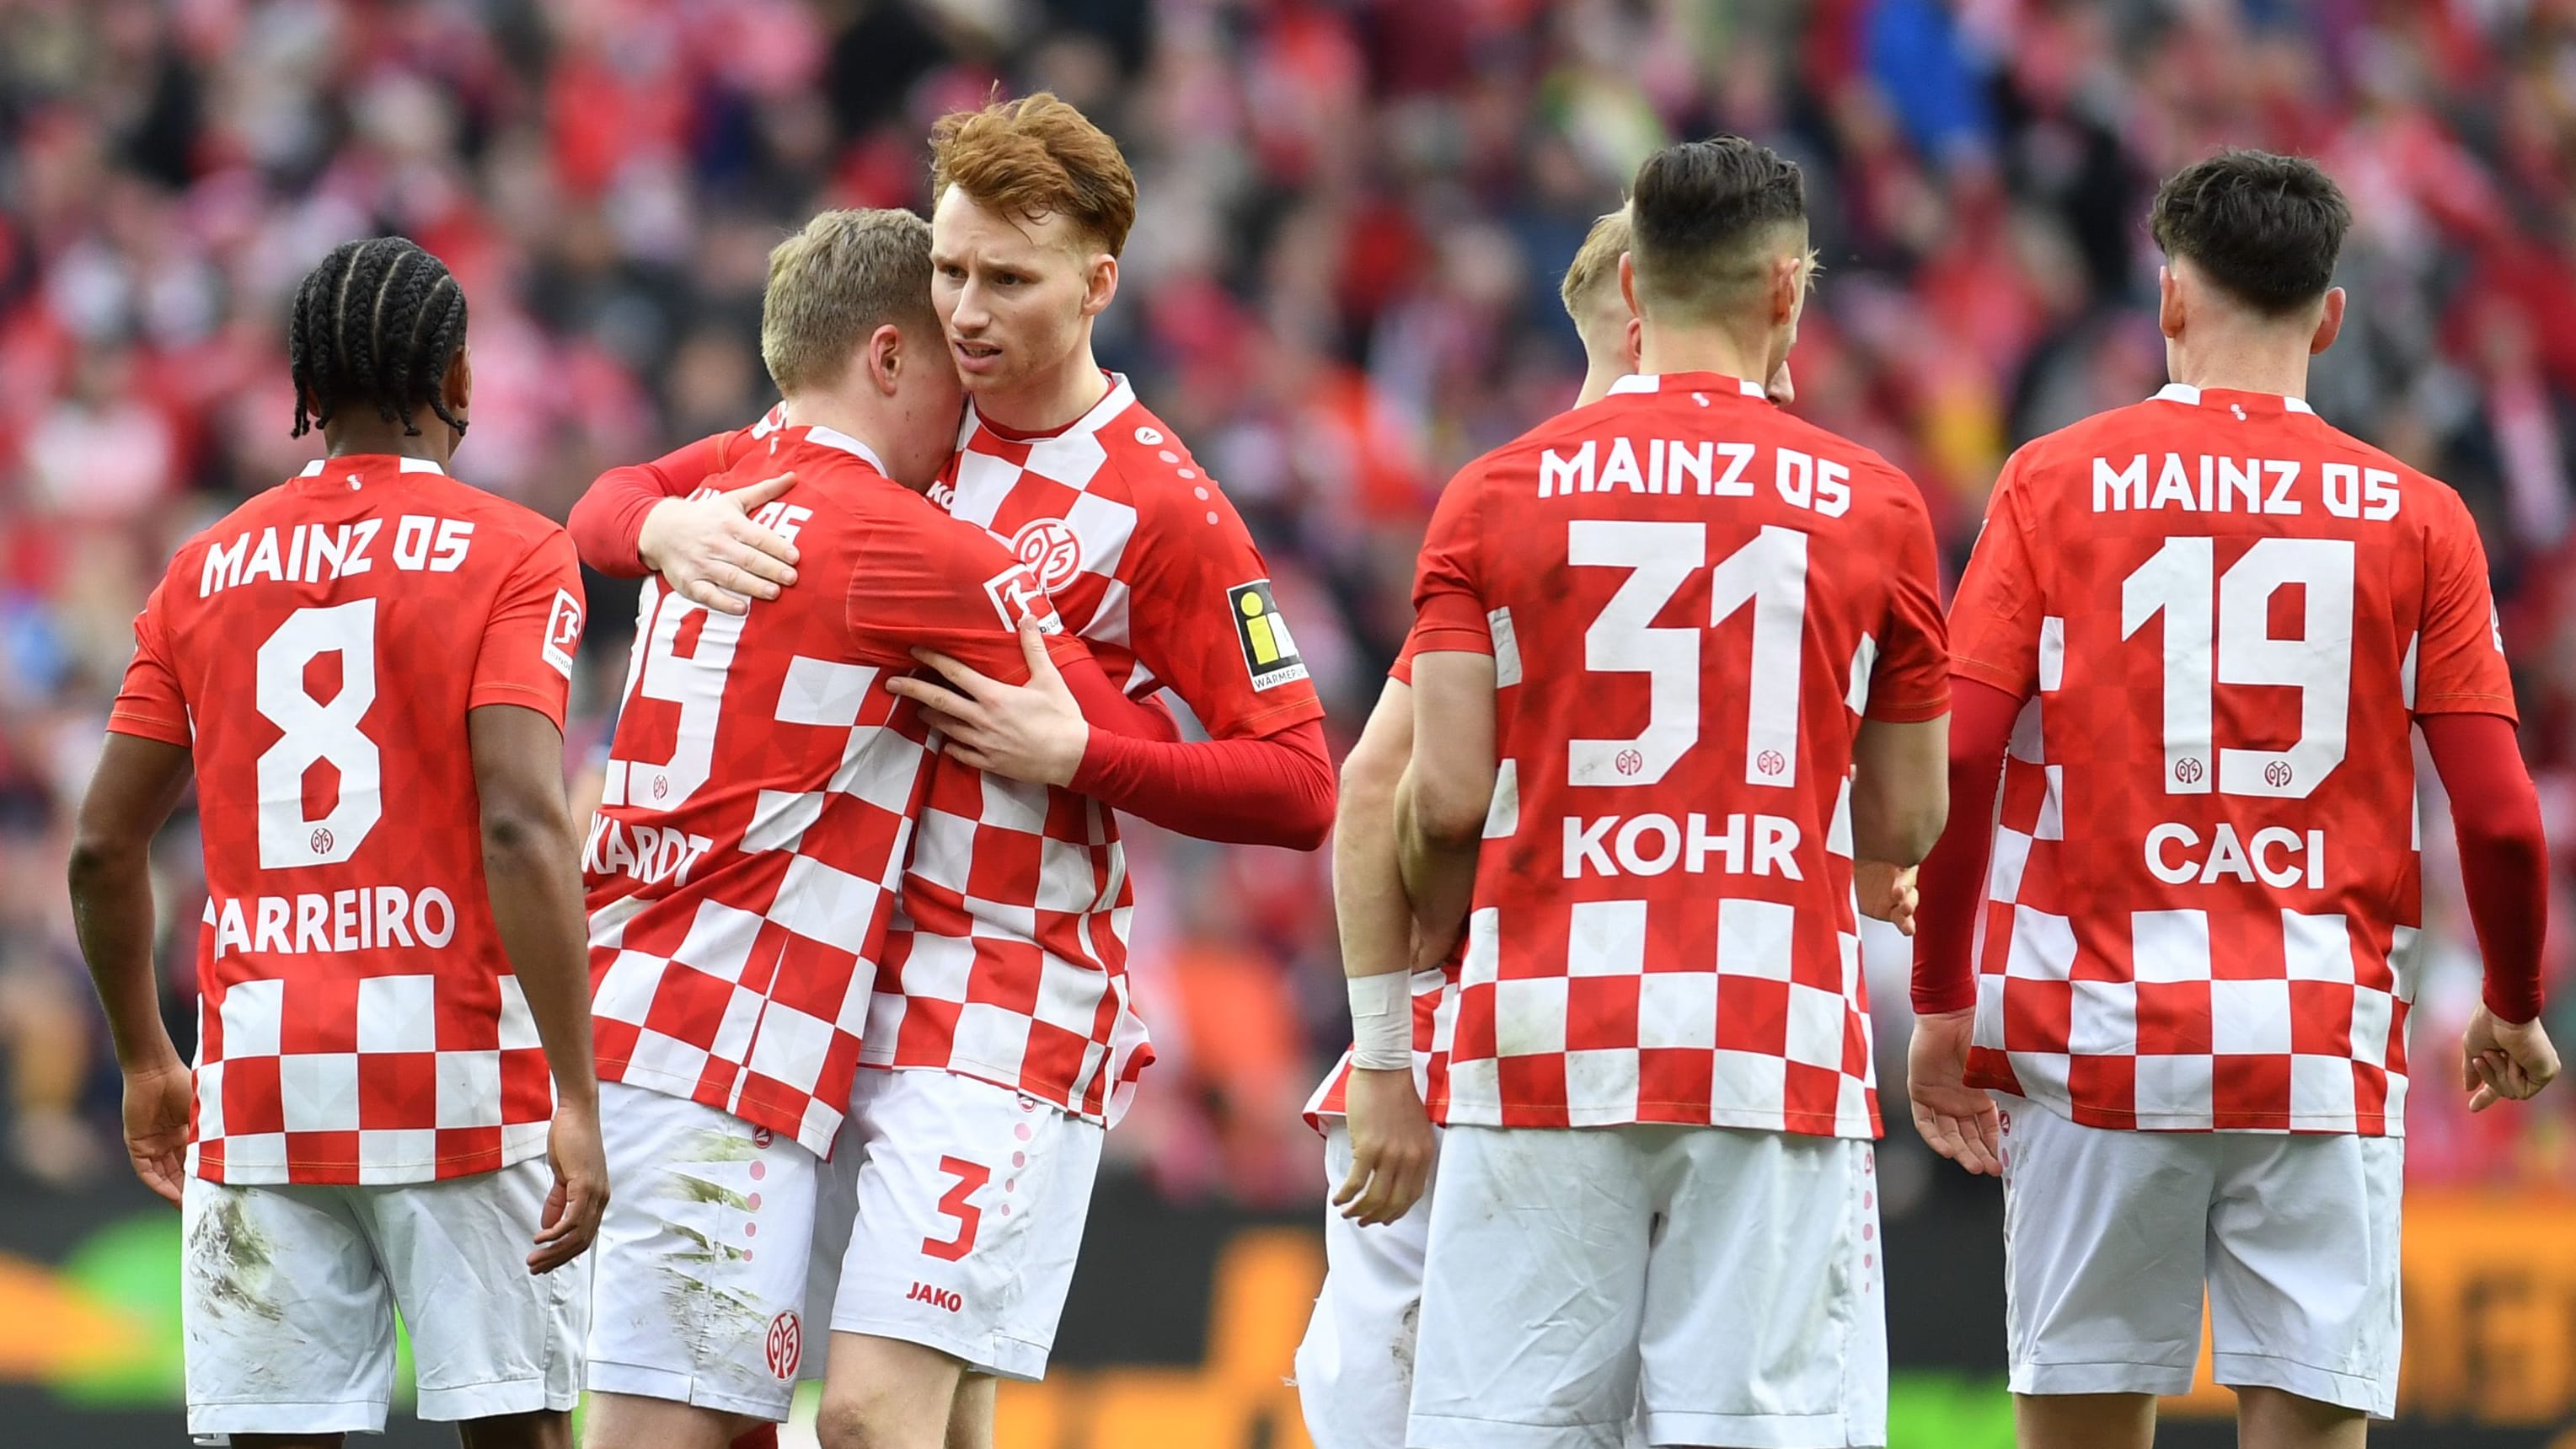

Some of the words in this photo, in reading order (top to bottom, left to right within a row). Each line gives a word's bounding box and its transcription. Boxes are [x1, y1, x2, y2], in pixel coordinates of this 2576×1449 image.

[1537, 437, 1756, 499] MAINZ
[1775, 446, 1851, 518] 05
[2091, 453, 2302, 514] MAINZ
[2322, 462, 2400, 521] 05
[199, 518, 383, 598] MAINZ
[392, 515, 476, 572] 05
[1254, 668, 1304, 690] WÄRMEP
[1567, 519, 1808, 788] 31
[2121, 536, 2355, 799] 19
[255, 597, 383, 870] 8
[581, 810, 715, 888] KARDT
[1561, 812, 1804, 881] KOHR
[2144, 822, 2324, 890] CACI
[214, 886, 456, 964] ARREIRO
[921, 1154, 991, 1263] 3
[905, 1280, 963, 1313] JAKO
